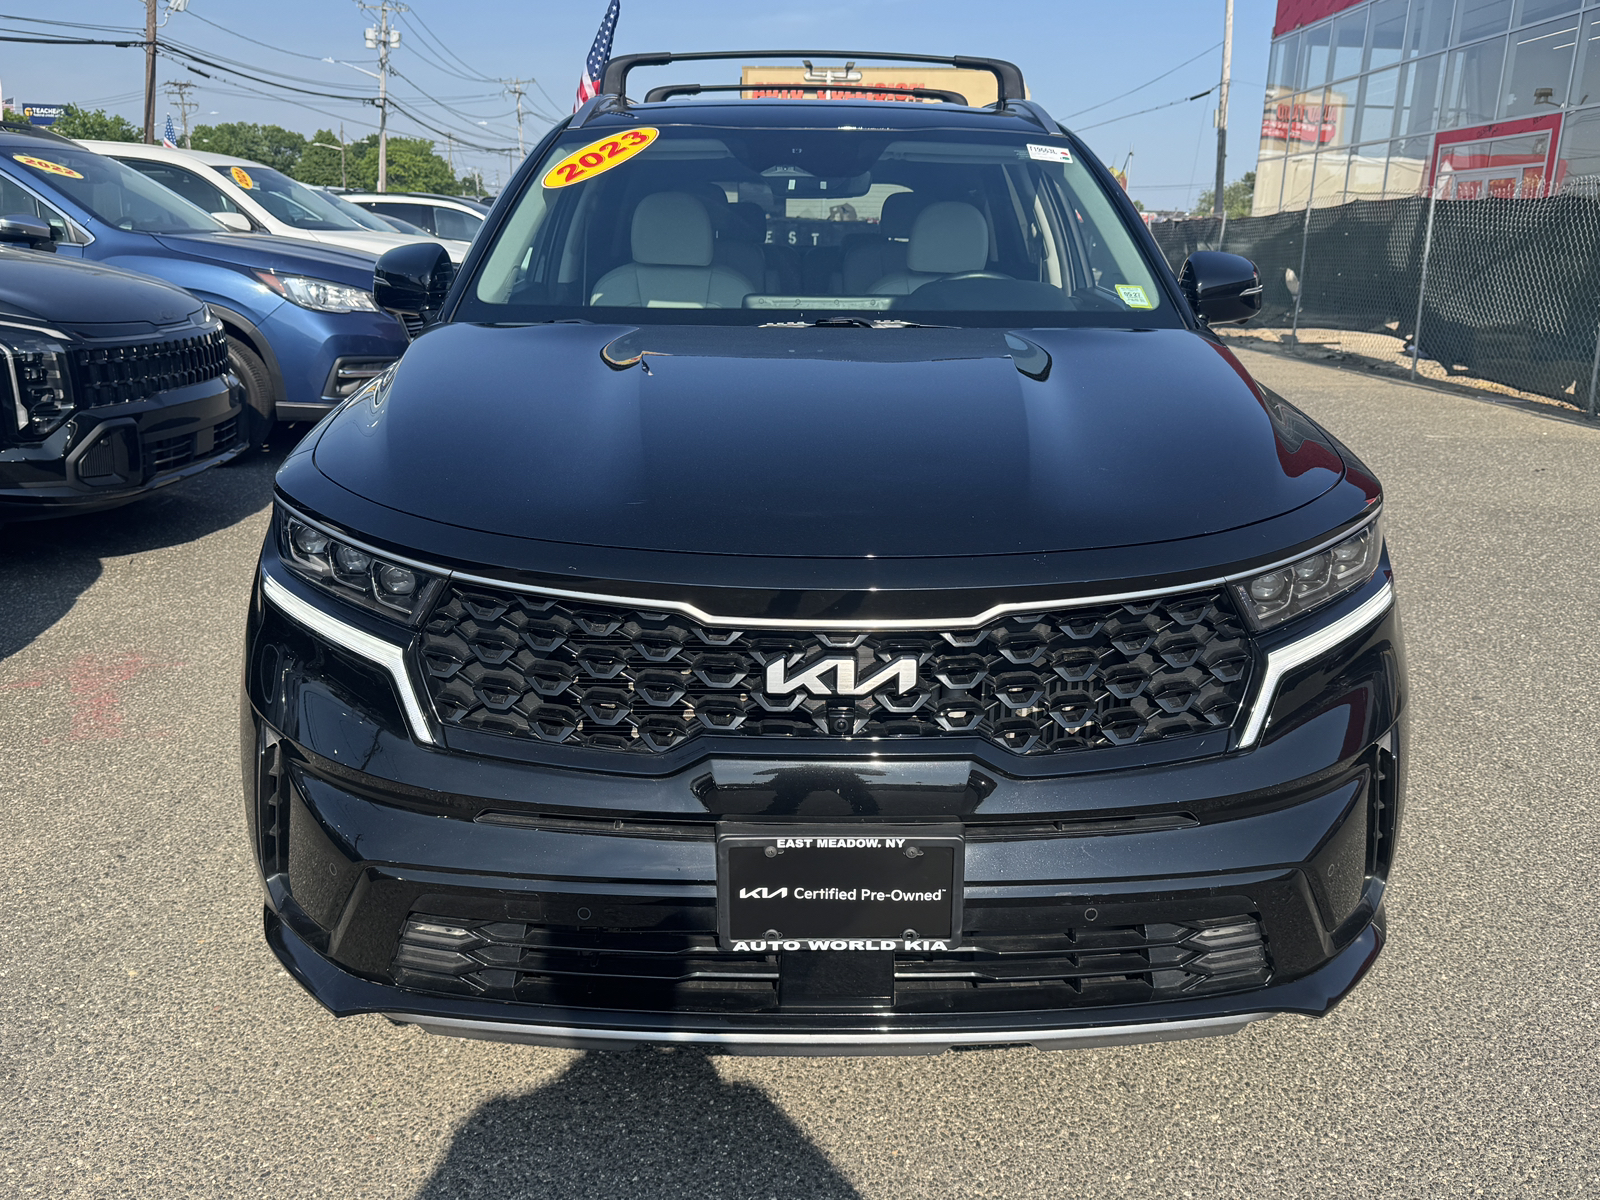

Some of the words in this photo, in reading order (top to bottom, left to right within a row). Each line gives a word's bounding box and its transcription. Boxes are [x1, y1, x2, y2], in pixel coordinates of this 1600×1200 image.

[556, 131, 650, 183] 2023
[766, 657, 917, 695] KIA
[777, 838, 813, 848] EAST
[885, 838, 906, 848] NY
[739, 887, 788, 899] KIA
[794, 887, 857, 901] Certified
[733, 940, 800, 951] AUTO
[807, 940, 896, 951] WORLD
[904, 940, 948, 951] KIA
